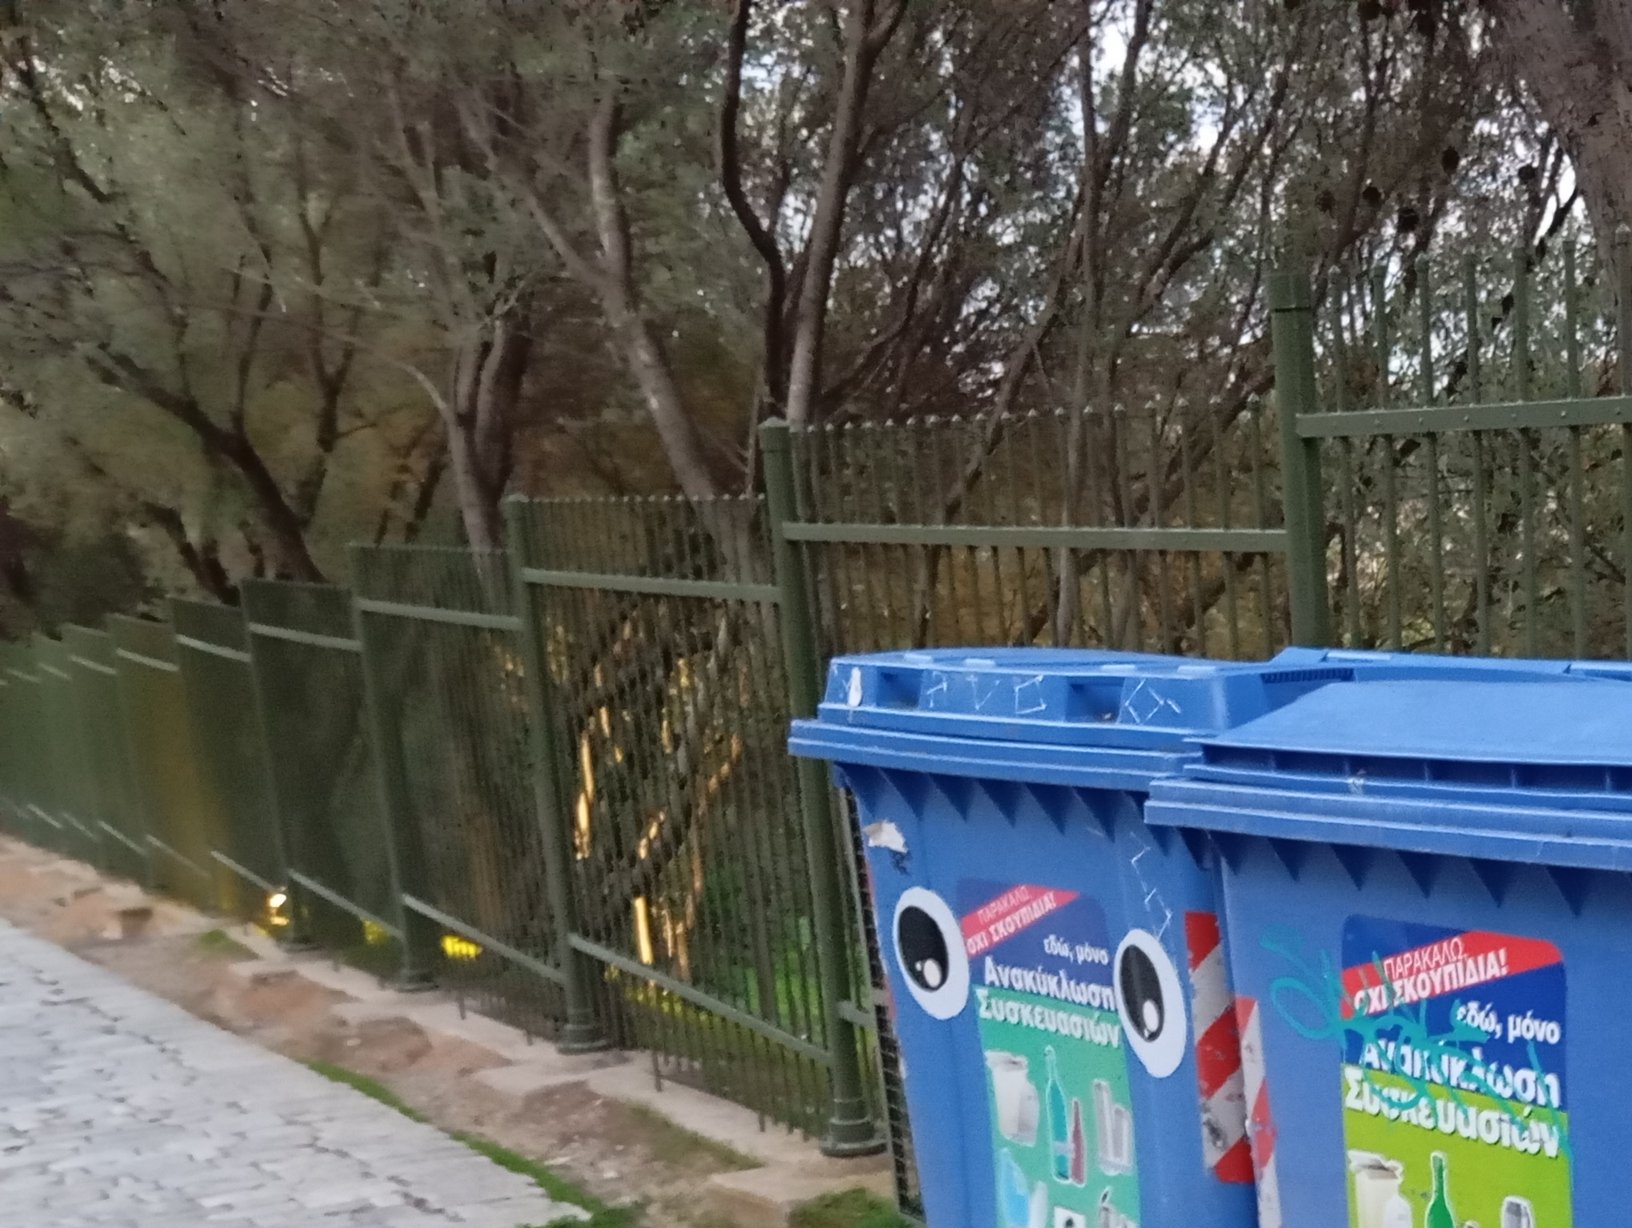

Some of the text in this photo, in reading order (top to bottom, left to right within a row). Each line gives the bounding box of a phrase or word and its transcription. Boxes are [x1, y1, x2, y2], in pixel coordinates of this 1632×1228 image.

[1074, 942, 1109, 966] μόνο
[1392, 948, 1508, 1007] ΣΚΟΥΠΙΔΙΑ!
[985, 955, 1118, 1011] Ανακύκλωση
[976, 988, 1120, 1048] Συσκευασιών
[1507, 1009, 1561, 1045] μόνο
[1344, 1066, 1560, 1158] Συσκευασιών
